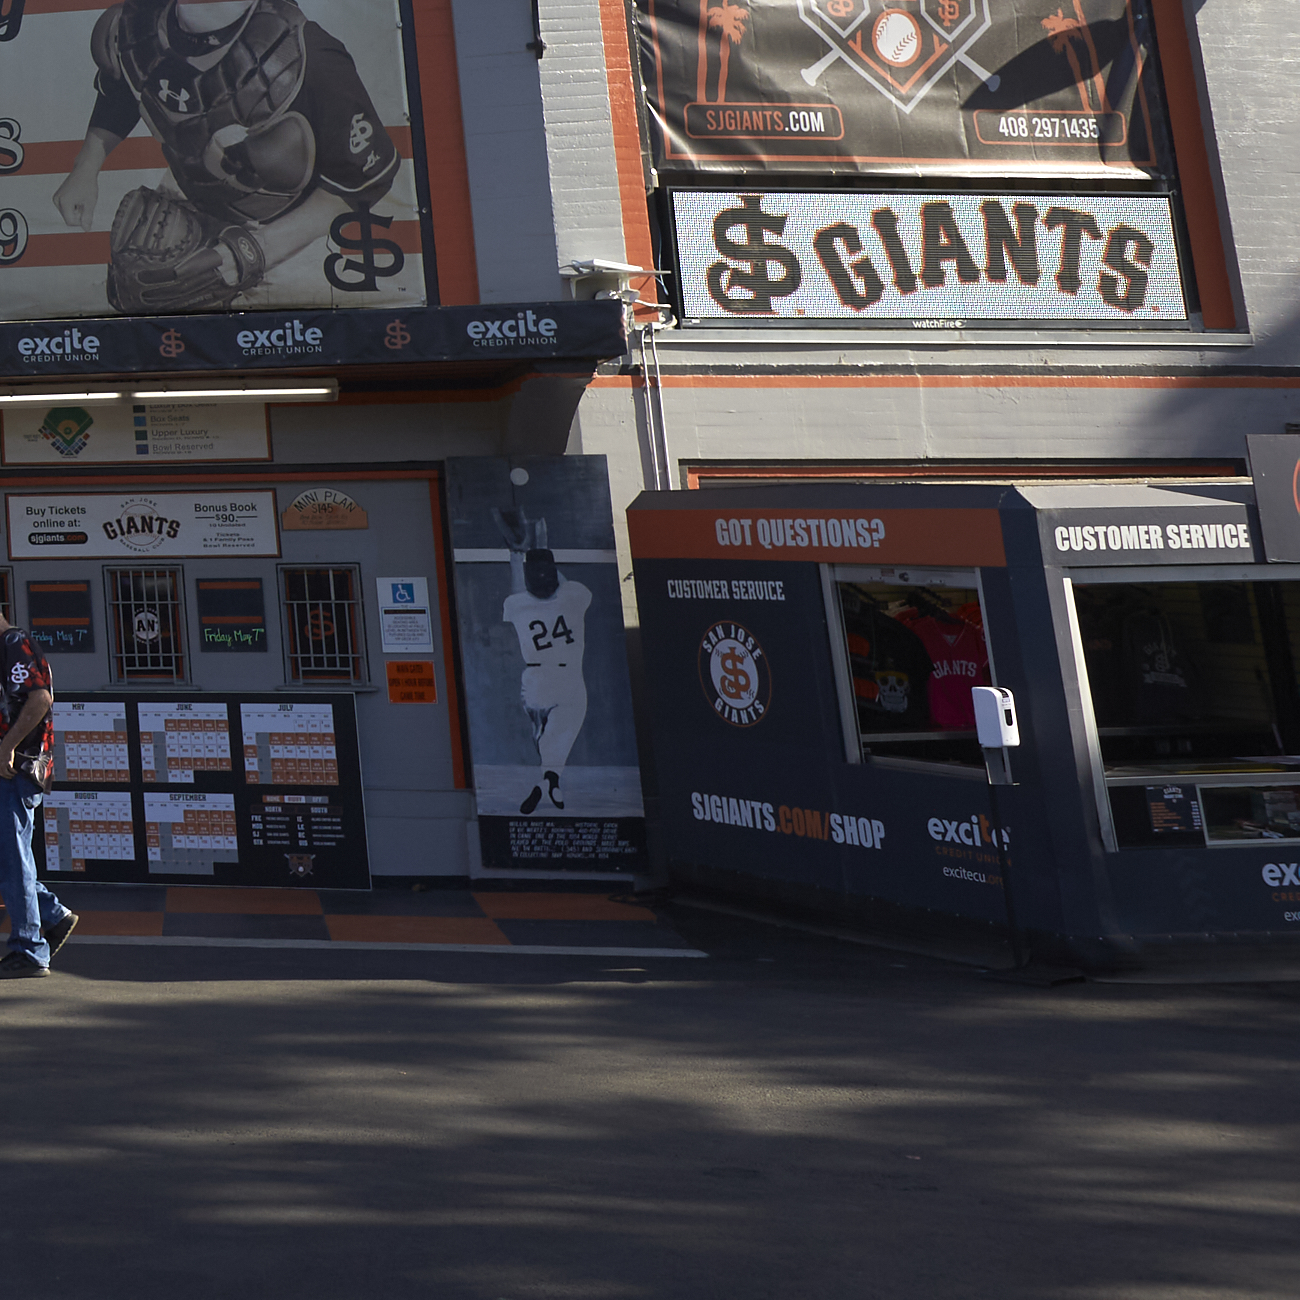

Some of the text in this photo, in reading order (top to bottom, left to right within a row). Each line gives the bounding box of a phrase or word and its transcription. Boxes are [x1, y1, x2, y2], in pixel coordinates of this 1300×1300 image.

[706, 109, 825, 133] SJGIANTS.COM
[813, 200, 1156, 313] GIANTS
[236, 319, 323, 348] excite
[466, 309, 558, 339] excite
[17, 328, 100, 355] excite
[242, 345, 322, 356] CREDIT UNION
[472, 336, 557, 347] CREDIT UNION
[23, 353, 99, 363] CREDIT UNION
[26, 506, 86, 517] Buy Tickets
[194, 502, 258, 513] Bonus Book
[293, 491, 318, 513] MINI
[32, 518, 65, 528] online
[102, 515, 181, 540] GIANTS
[715, 518, 886, 550] GOT QUESTIONS?
[1055, 522, 1250, 551] CUSTOMER SERVICE
[667, 579, 785, 601] CUSTOMER SERVICE
[203, 628, 253, 647] Friday May
[529, 615, 574, 650] 24
[702, 624, 762, 661] SAN JOSE
[176, 703, 193, 711] JUNE
[278, 704, 294, 712] JULY
[714, 698, 765, 725] GIANTS
[170, 793, 207, 801] SEPTEMBER
[691, 792, 885, 850] SJGIANTS.COM/SHOP
